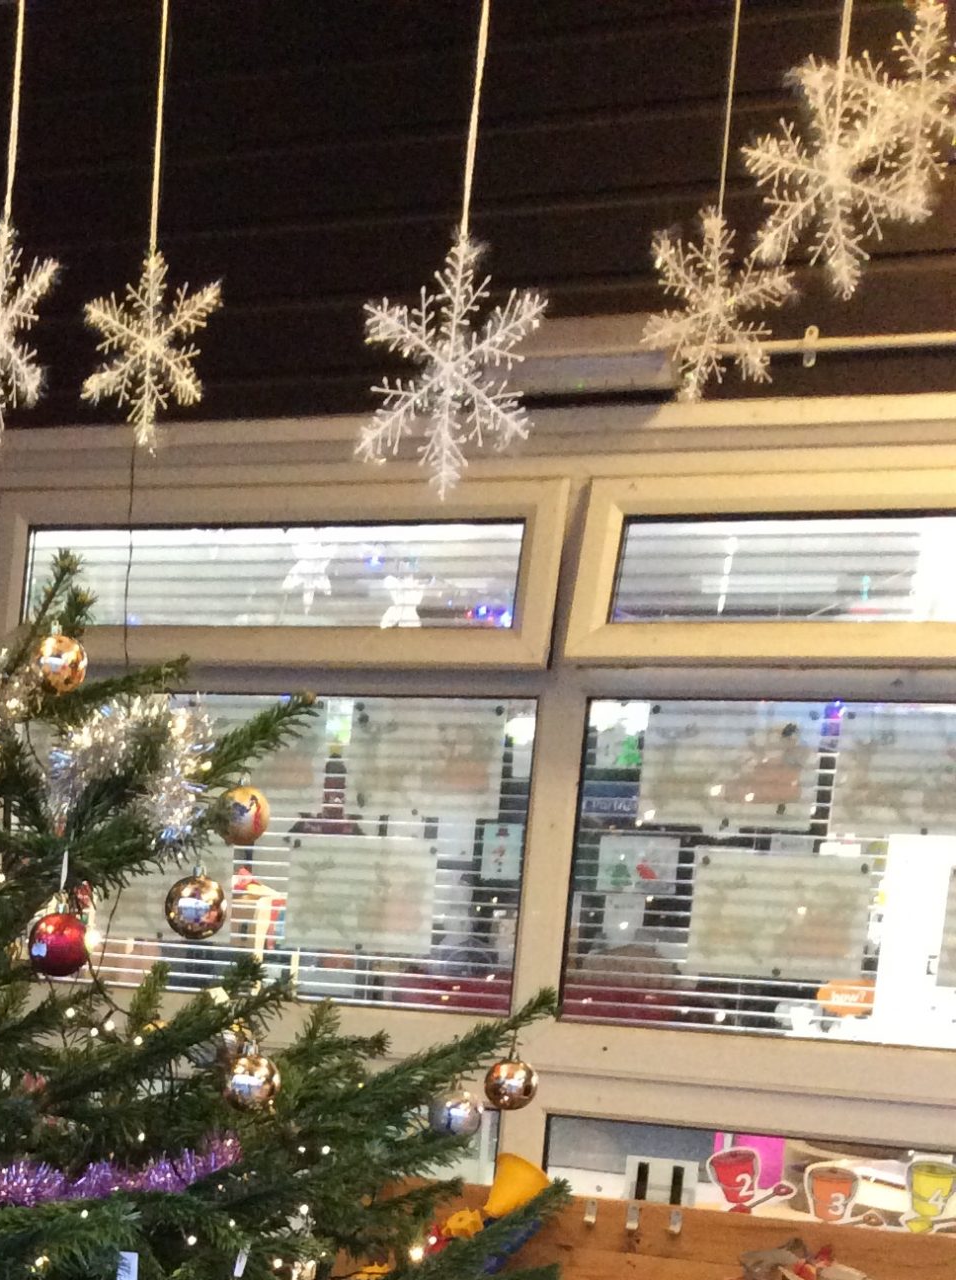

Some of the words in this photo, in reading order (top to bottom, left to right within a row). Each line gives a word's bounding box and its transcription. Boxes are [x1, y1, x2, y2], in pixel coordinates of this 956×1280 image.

[735, 1173, 753, 1197] 2
[828, 1192, 845, 1216] 3
[927, 1189, 946, 1213] 4
